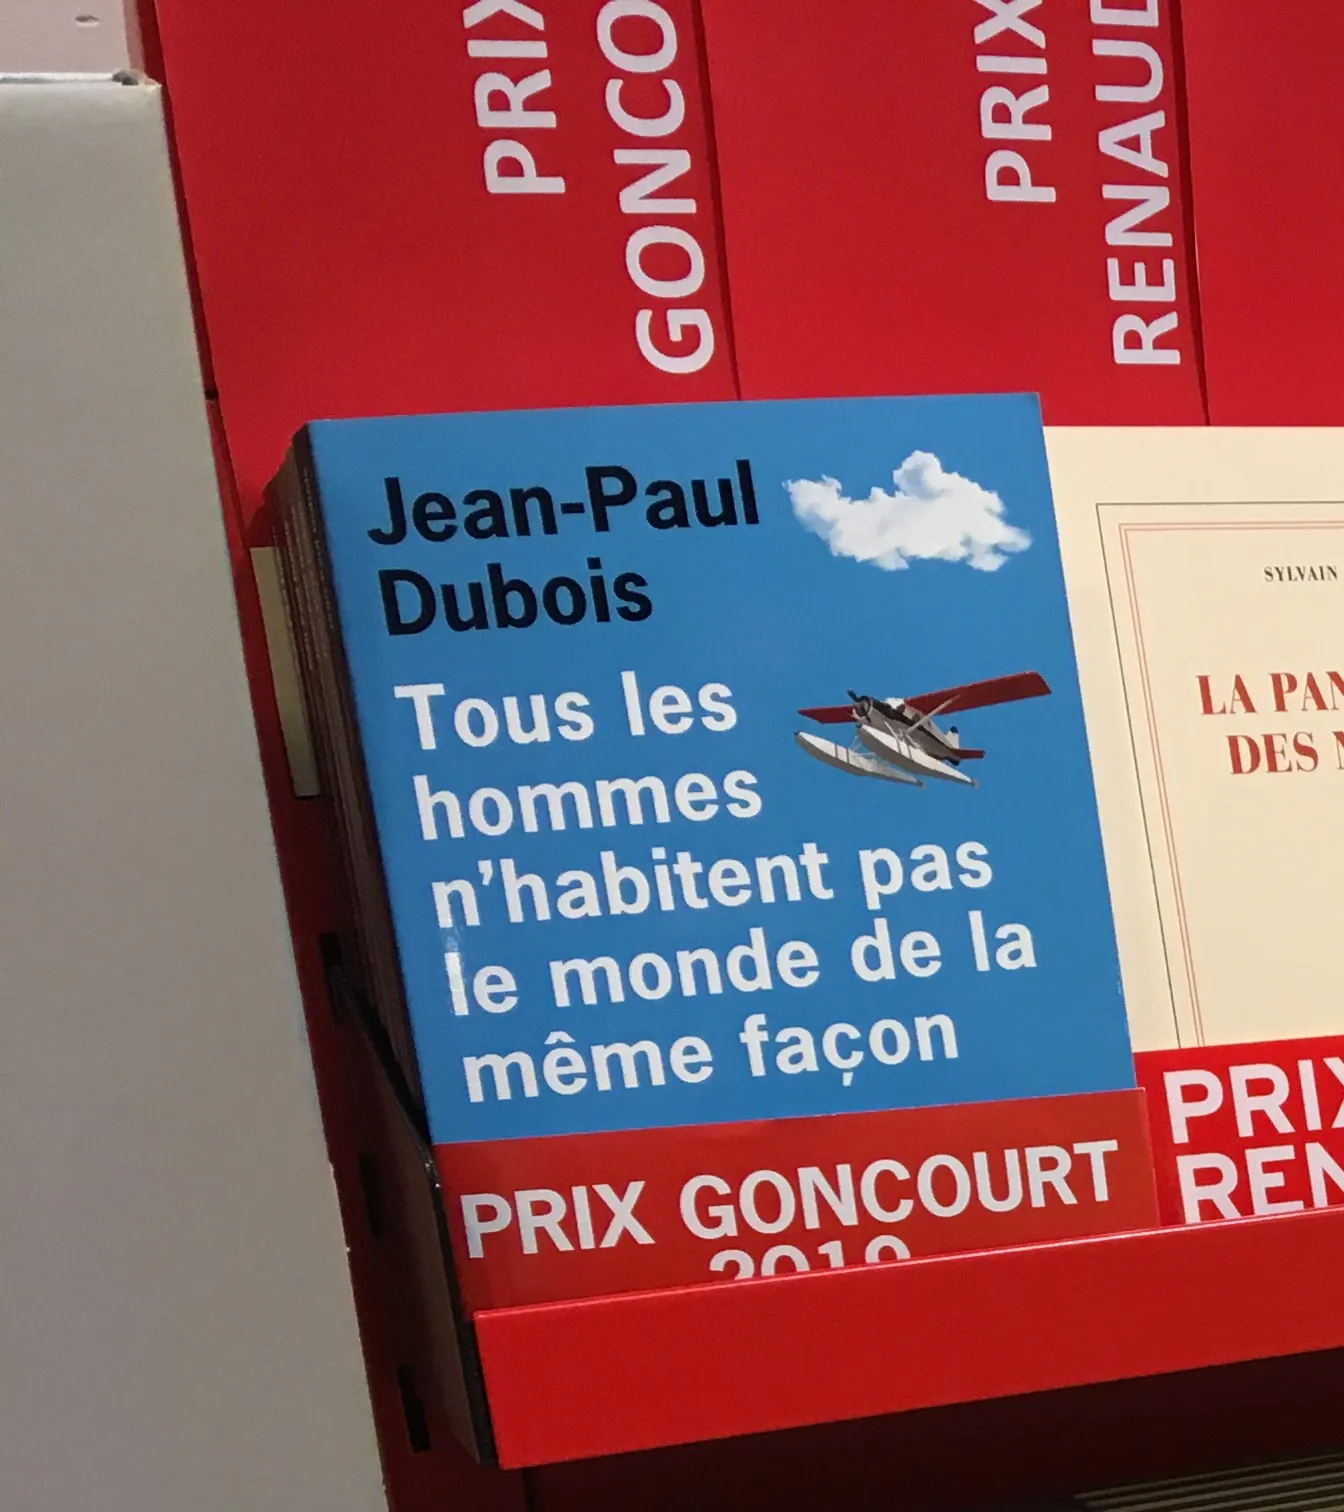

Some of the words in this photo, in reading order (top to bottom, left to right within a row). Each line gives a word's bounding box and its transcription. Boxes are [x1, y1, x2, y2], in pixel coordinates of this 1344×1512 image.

[974, 0, 1056, 201] PRIX
[367, 459, 760, 547] Jean-Paul
[378, 557, 652, 636] Dubois
[1262, 562, 1340, 583] SYLVAIN
[394, 682, 594, 751] Tous
[620, 670, 738, 737] les
[1195, 670, 1257, 717] LA
[1225, 731, 1320, 776] DES
[412, 768, 763, 841] hommes
[431, 842, 834, 929] n'habitent
[859, 838, 993, 910] pas
[445, 950, 518, 1017] le
[549, 926, 821, 1008] monde
[850, 917, 942, 983] de
[968, 910, 1037, 971] la
[462, 1030, 714, 1103] même
[739, 1011, 959, 1088] façon
[459, 1180, 655, 1259] PRIX
[679, 1139, 1119, 1241] GONCOURT
